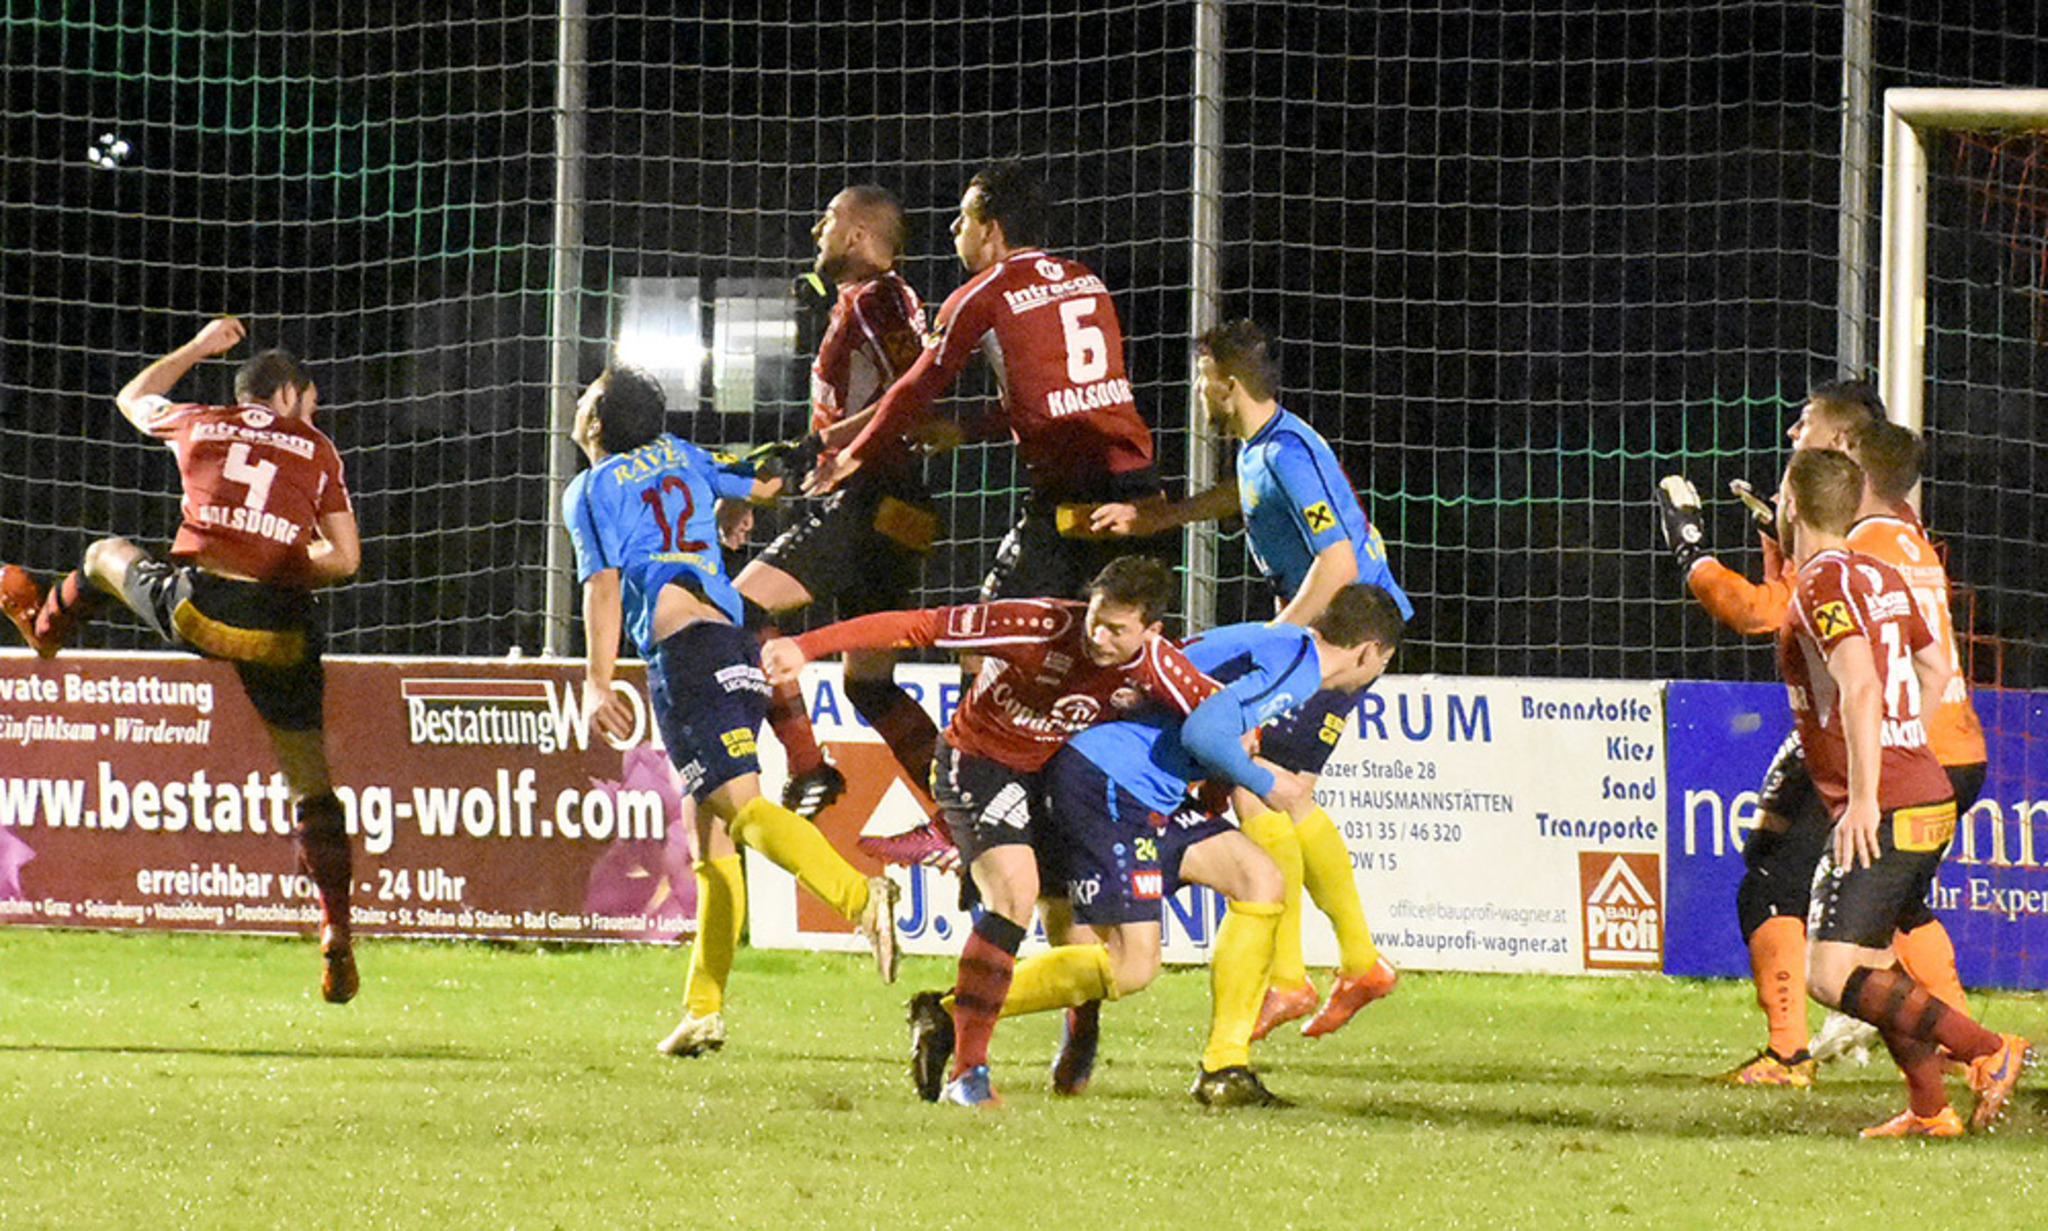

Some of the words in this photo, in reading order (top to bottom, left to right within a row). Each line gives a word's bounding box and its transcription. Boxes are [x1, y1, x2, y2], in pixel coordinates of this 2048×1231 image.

[1059, 297, 1108, 384] 6
[222, 442, 278, 511] 4
[640, 474, 710, 553] 12
[64, 673, 214, 713] Bestattung
[1520, 695, 1652, 723] Brennstoffe
[113, 717, 212, 744] Würdevoll
[408, 698, 555, 754] Bestattung
[1606, 735, 1654, 761] Kies
[1362, 759, 1414, 780] Straße
[1417, 762, 1437, 780] 28
[1350, 788, 1514, 813] HAUSMANNSTÄTTEN
[1602, 774, 1656, 800] Sand
[1344, 820, 1373, 840] 031
[1378, 822, 1397, 840] 35
[1410, 823, 1430, 841] 46
[1434, 824, 1462, 842] 320
[1535, 811, 1658, 845] Transporte
[1133, 837, 1158, 862] 24
[1381, 853, 1398, 871] 15
[137, 863, 273, 897] erreichbar
[378, 868, 411, 900] 24
[416, 867, 466, 901] Uhr
[1605, 905, 1639, 921] BAU
[1587, 905, 1659, 950] Profi
